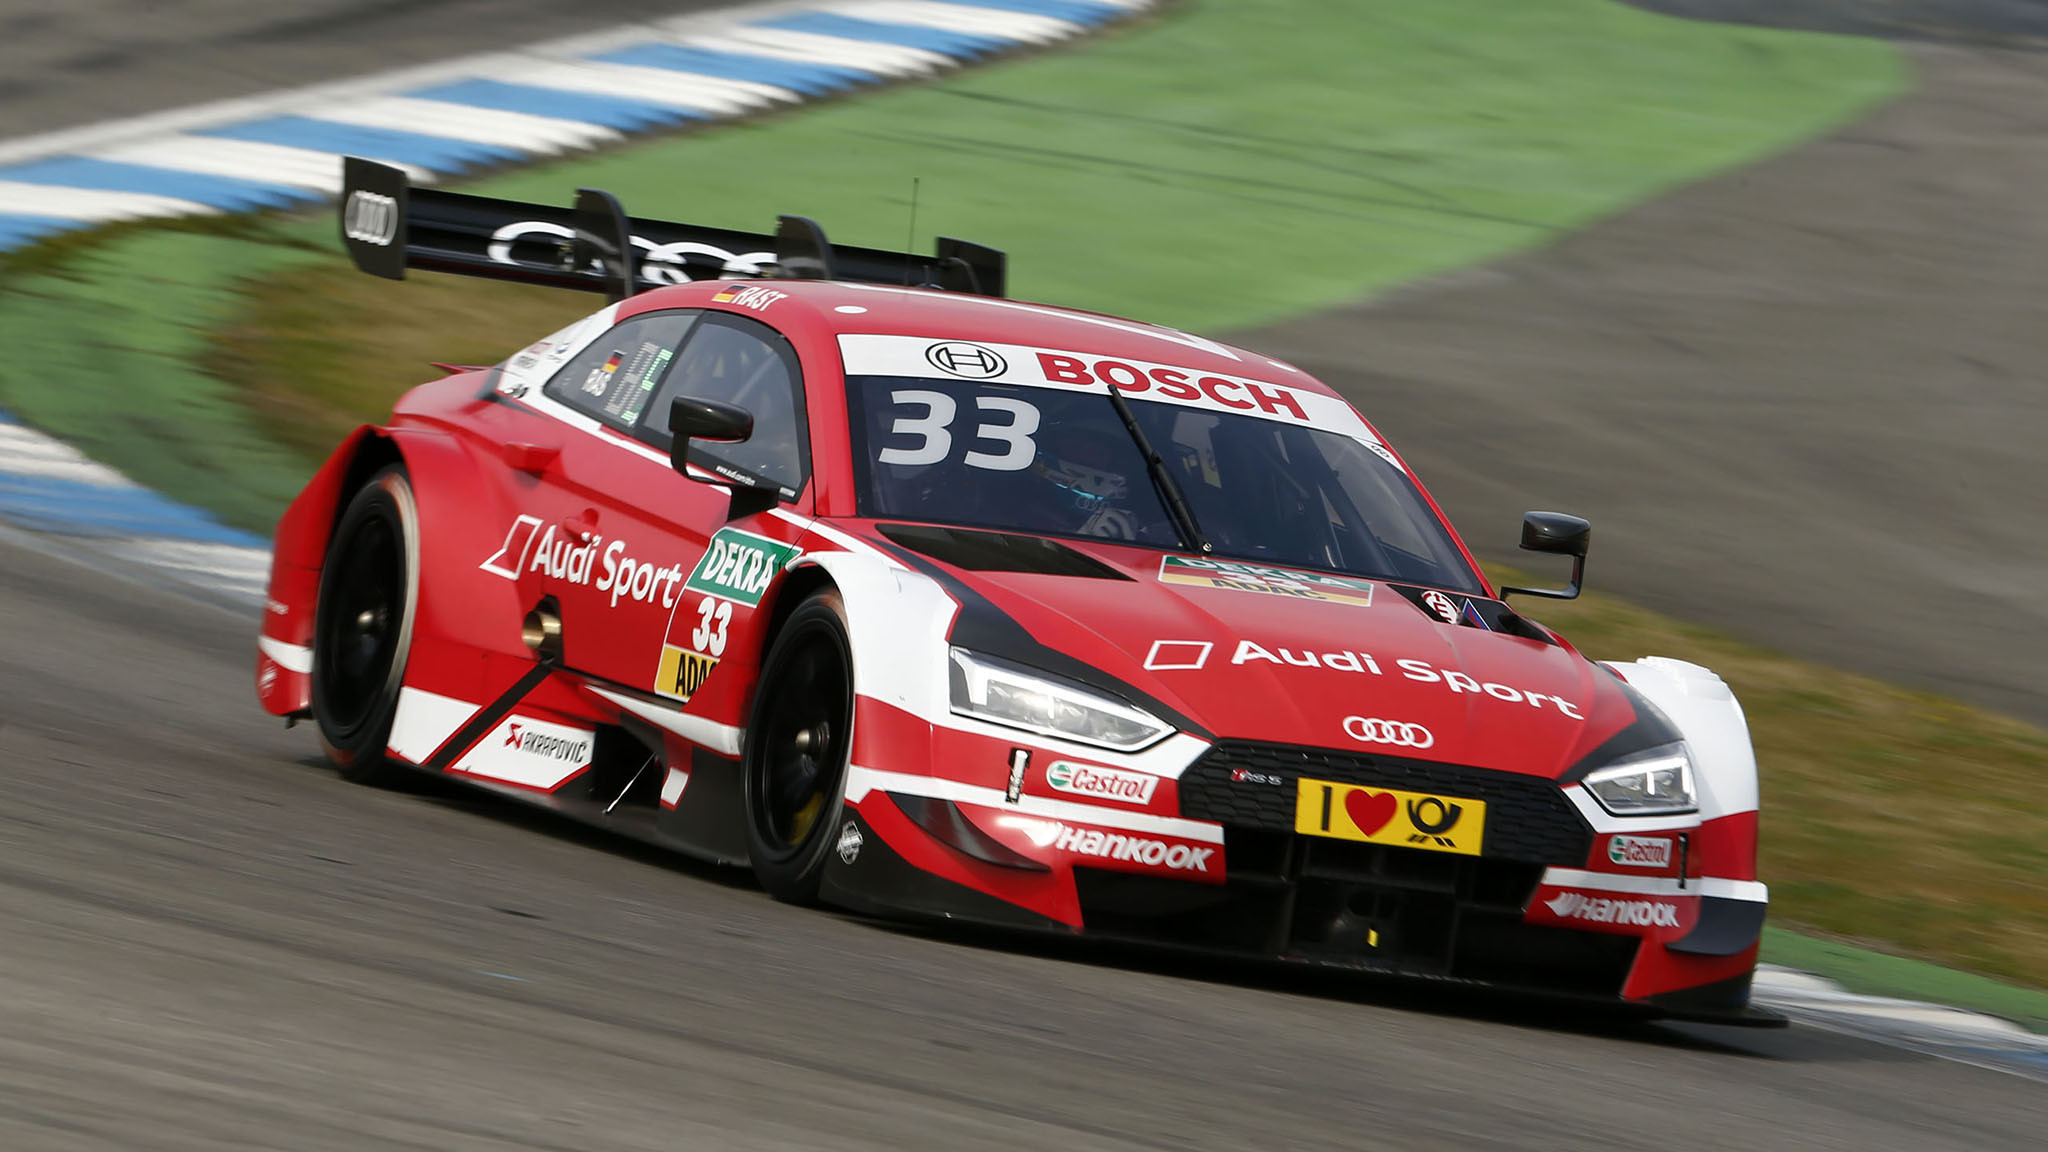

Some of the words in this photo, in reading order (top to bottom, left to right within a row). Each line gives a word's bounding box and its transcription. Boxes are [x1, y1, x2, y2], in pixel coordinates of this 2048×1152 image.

[731, 286, 788, 311] RAST
[1035, 352, 1310, 421] BOSCH
[878, 390, 1041, 472] 33
[530, 524, 600, 586] Audi
[596, 540, 682, 608] Sport
[701, 538, 777, 597] DEKRA
[1177, 556, 1356, 589] DEKRA
[693, 596, 733, 657] 33
[675, 653, 717, 697] ADA
[1231, 640, 1383, 675] Audi
[1396, 658, 1585, 720] Sport
[1072, 768, 1147, 799] Castrol
[1321, 785, 1332, 832] I
[1625, 839, 1668, 863] Castrol
